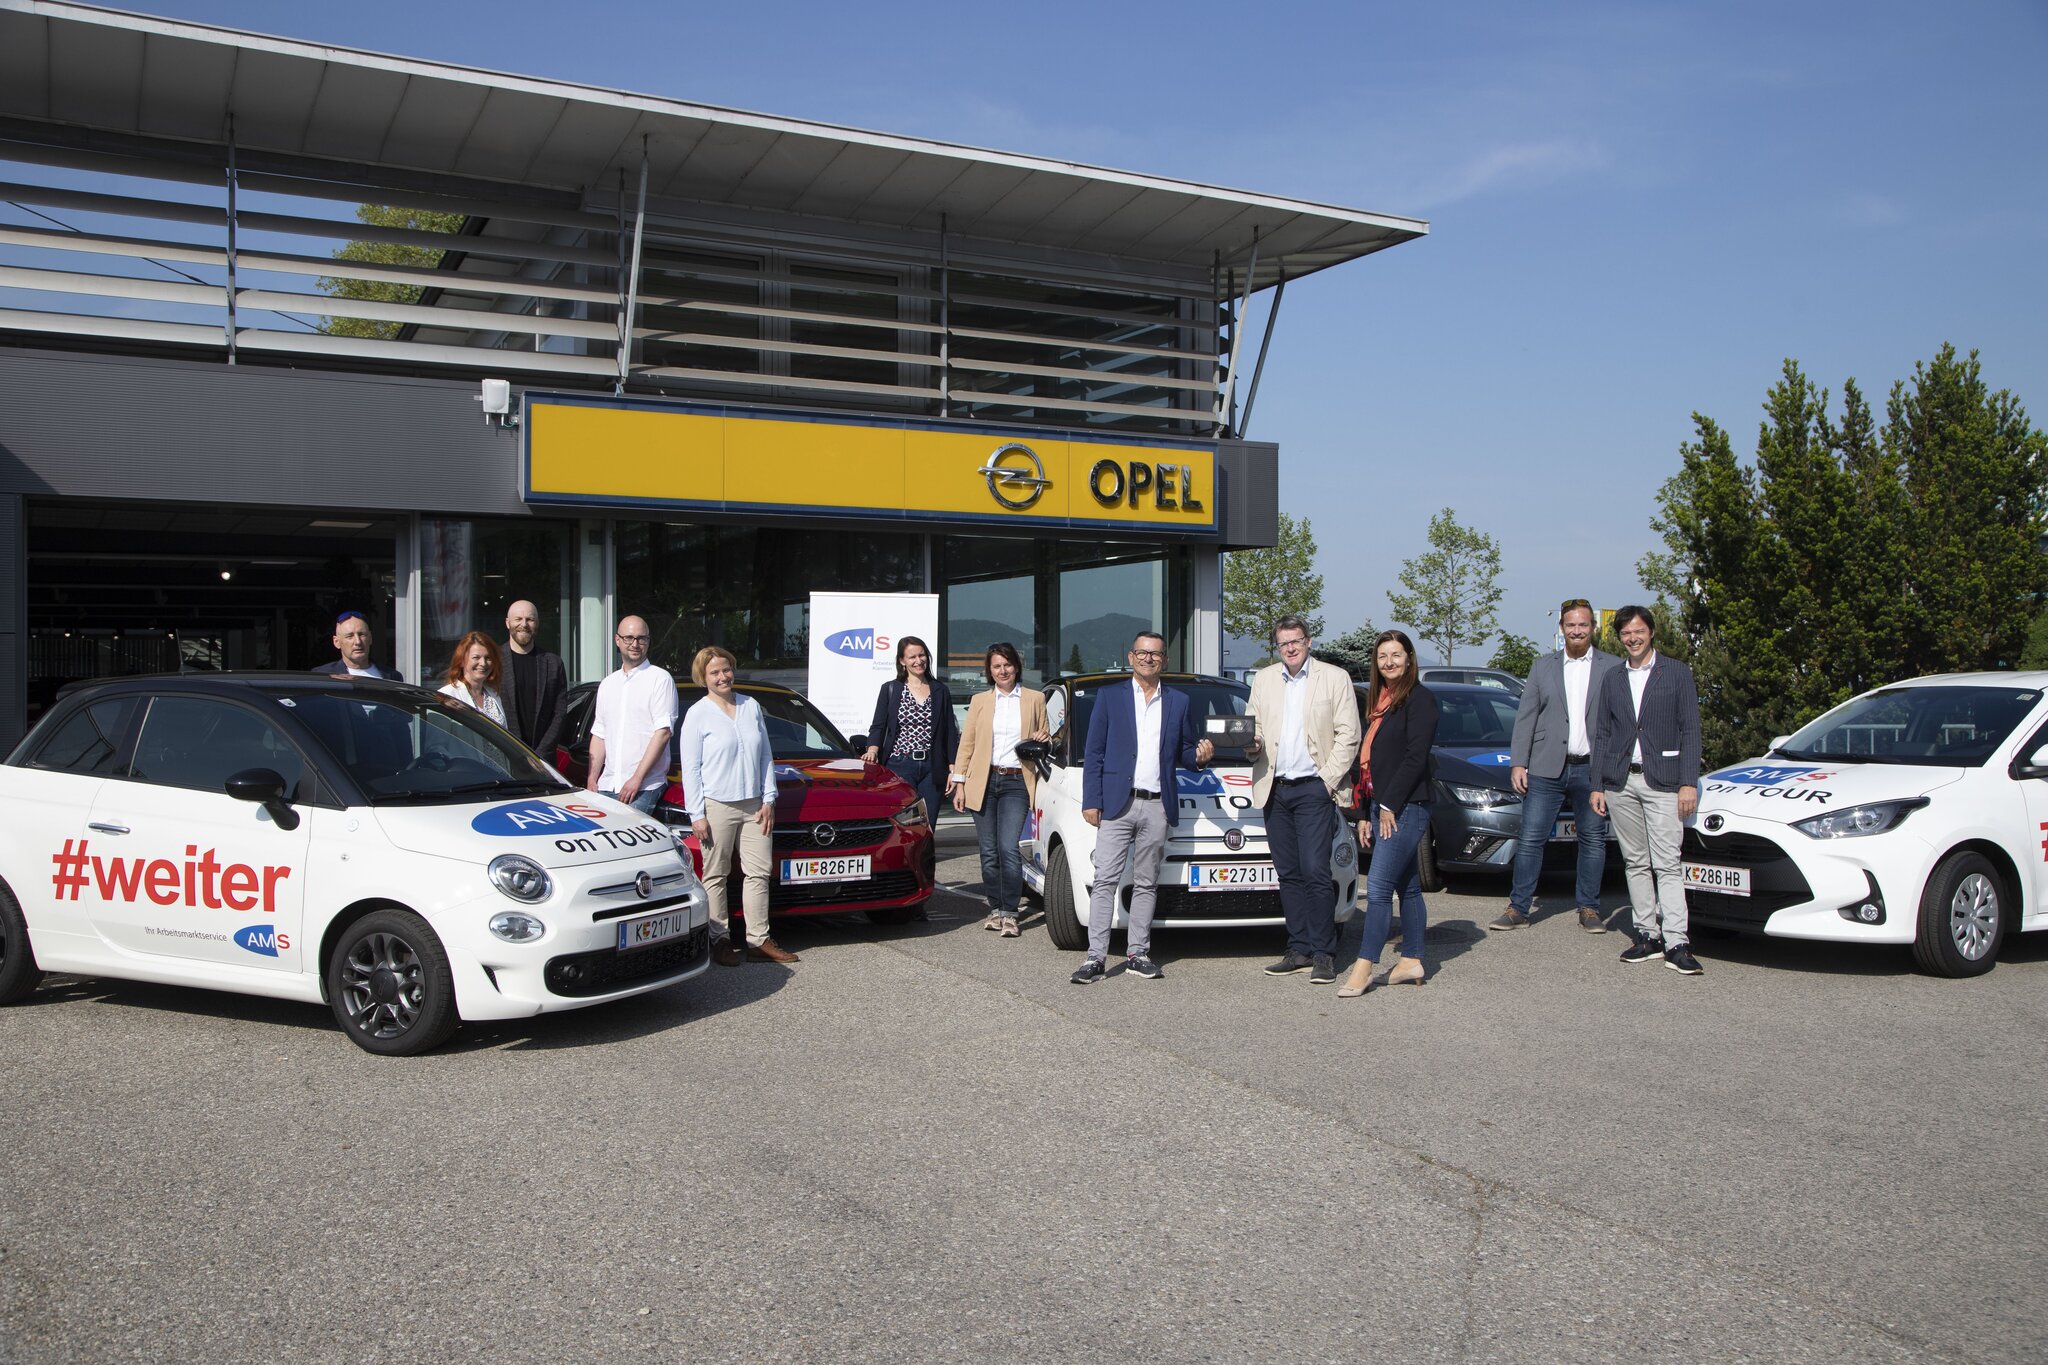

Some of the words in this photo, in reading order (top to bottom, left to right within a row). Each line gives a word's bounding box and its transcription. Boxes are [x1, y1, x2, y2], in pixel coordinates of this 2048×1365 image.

[1089, 458, 1203, 509] OPEL
[839, 635, 891, 651] AMS
[1176, 774, 1253, 787] MS
[1729, 768, 1837, 782] AMS
[1180, 797, 1197, 809] n
[1207, 795, 1252, 810] TO
[1706, 784, 1737, 793] on
[1744, 785, 1832, 804] TOUR
[506, 804, 607, 829] AMS
[555, 837, 597, 853] on
[594, 824, 667, 849] TOUR
[52, 839, 292, 912] #weiter
[796, 862, 808, 876] VI
[820, 860, 845, 875] 826
[848, 859, 864, 874] FH
[1209, 868, 1218, 883] K
[1229, 868, 1257, 883] 273
[1685, 866, 1692, 881] K
[1700, 868, 1722, 885] 286
[1725, 871, 1740, 887] HB
[144, 926, 156, 935] Ihr
[156, 927, 228, 942] Arbeitsmarktservice
[636, 923, 642, 942] K
[651, 918, 669, 938] 217
[247, 932, 290, 949] AMS
